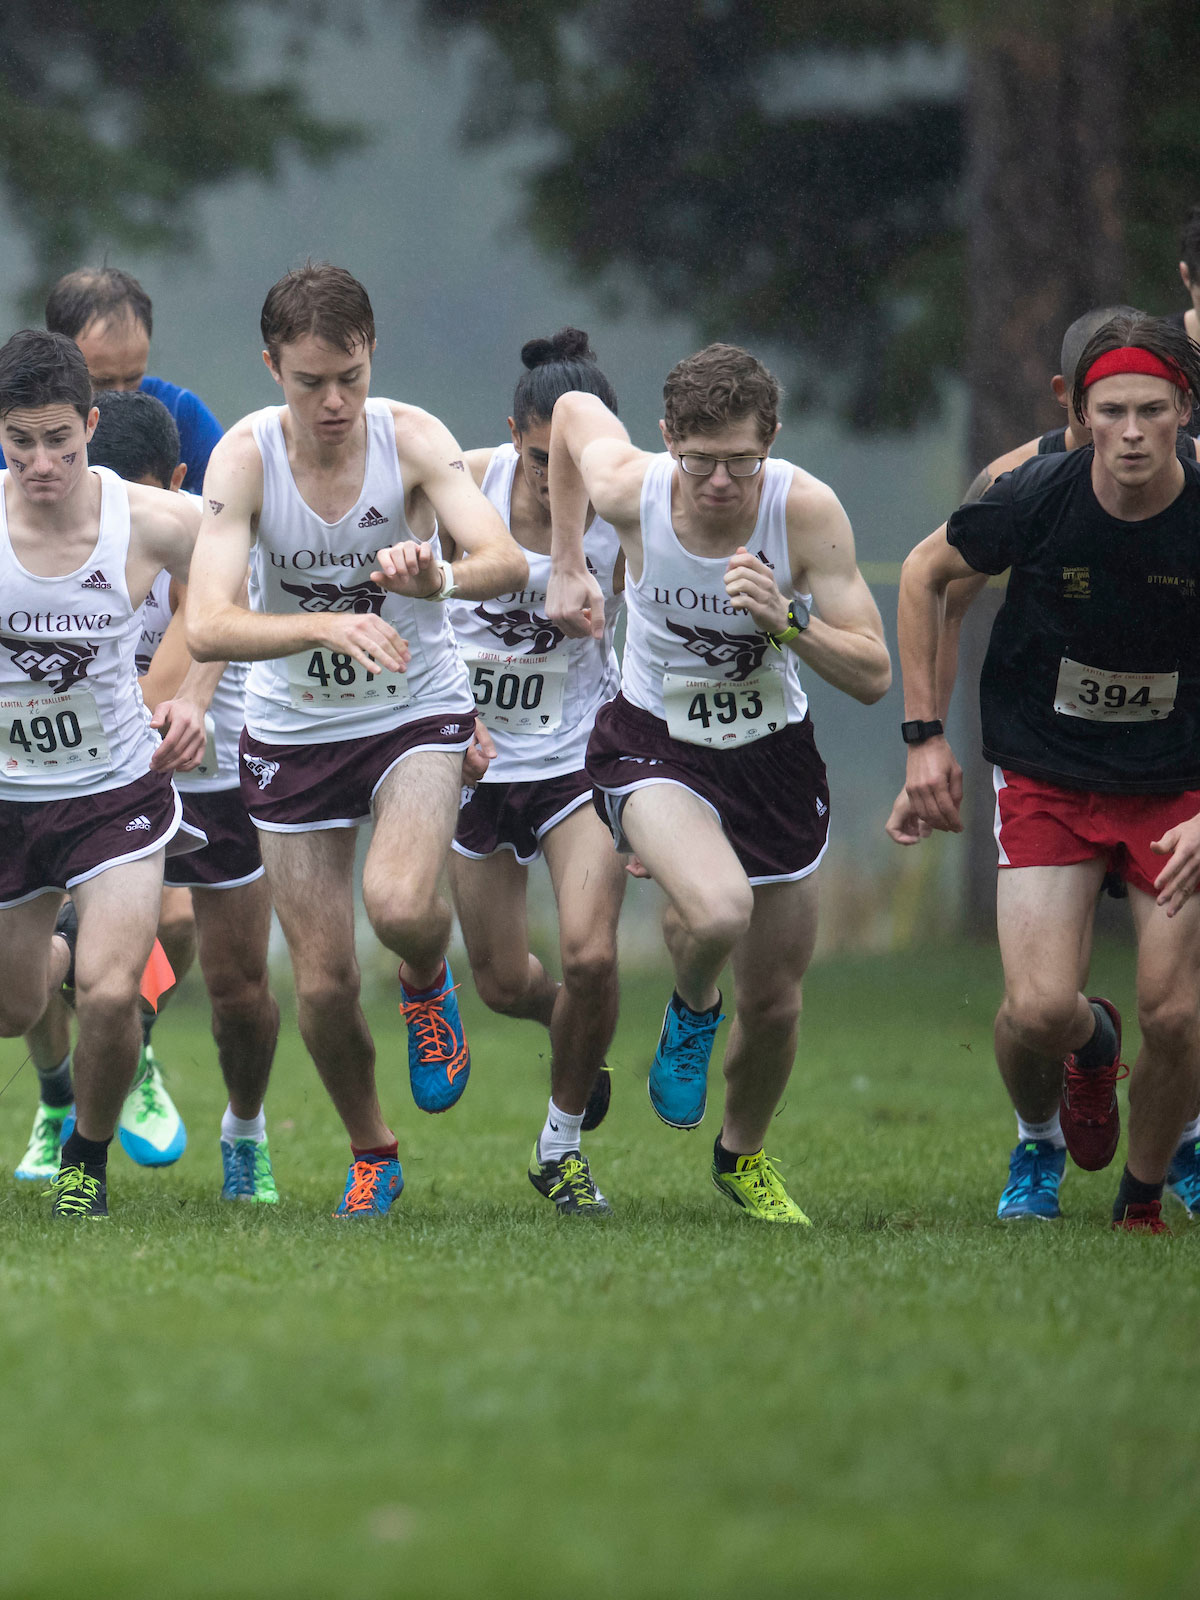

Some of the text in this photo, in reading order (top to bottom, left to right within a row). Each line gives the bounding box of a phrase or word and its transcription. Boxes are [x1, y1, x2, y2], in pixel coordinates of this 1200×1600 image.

[358, 516, 389, 529] adidas
[81, 582, 112, 590] adidas
[472, 667, 545, 710] 500
[1078, 679, 1152, 708] 394
[688, 690, 763, 728] 493
[9, 711, 82, 753] 490
